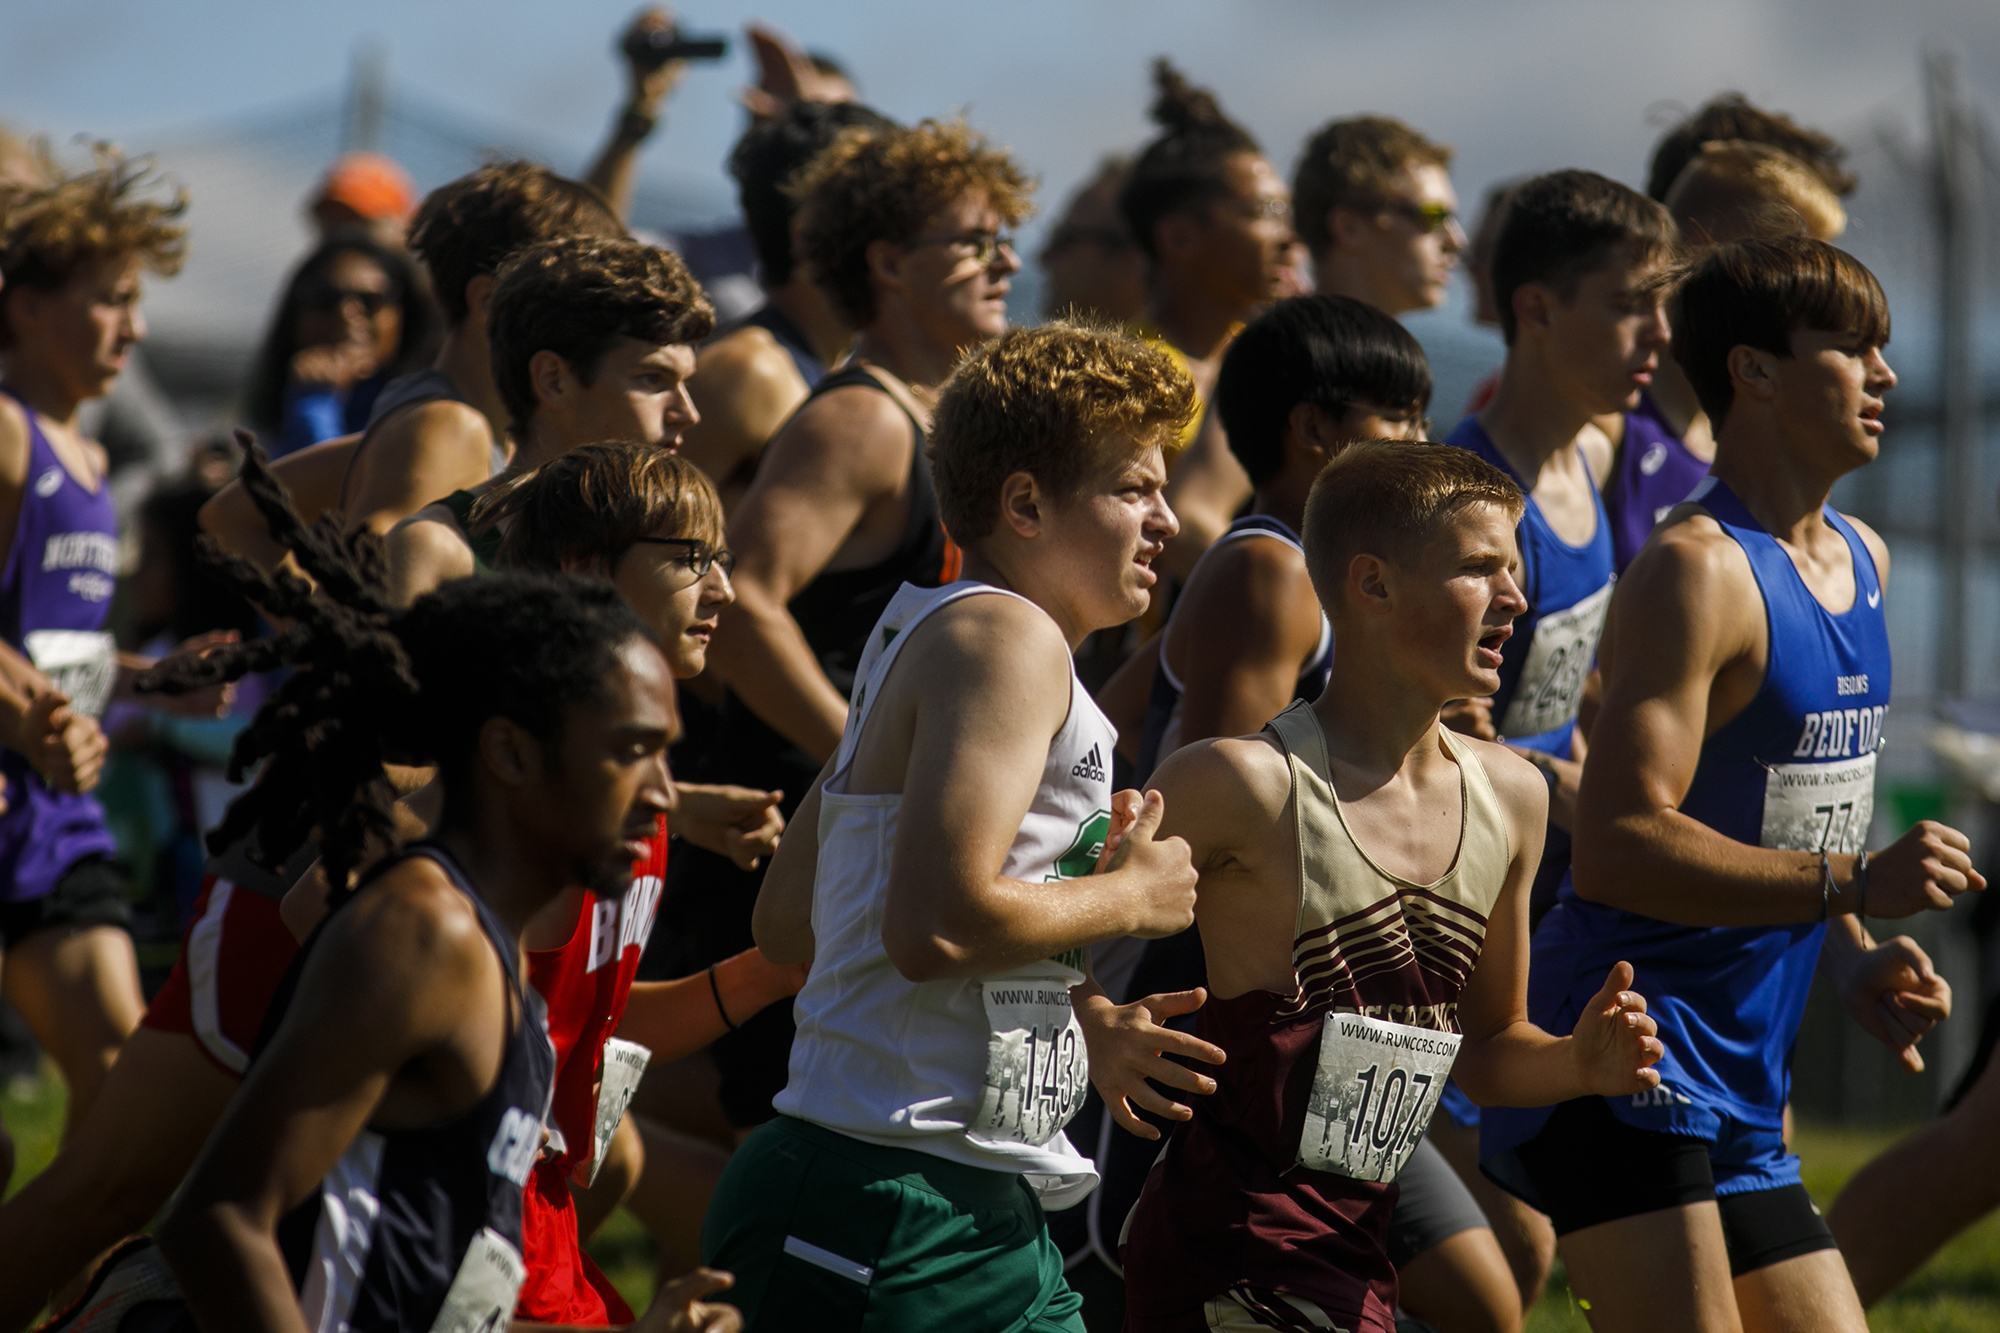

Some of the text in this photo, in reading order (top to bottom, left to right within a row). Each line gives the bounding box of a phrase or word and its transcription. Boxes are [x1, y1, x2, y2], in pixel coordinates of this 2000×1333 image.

[1837, 673, 1869, 696] BISONS
[1793, 703, 1889, 758] BEDFOR
[1072, 763, 1105, 783] adidas
[1813, 800, 1854, 854] 77
[1341, 1021, 1457, 1057] WWW.RUNCCRS.COM
[1022, 1024, 1076, 1117] 143
[1351, 1061, 1434, 1154] 107
